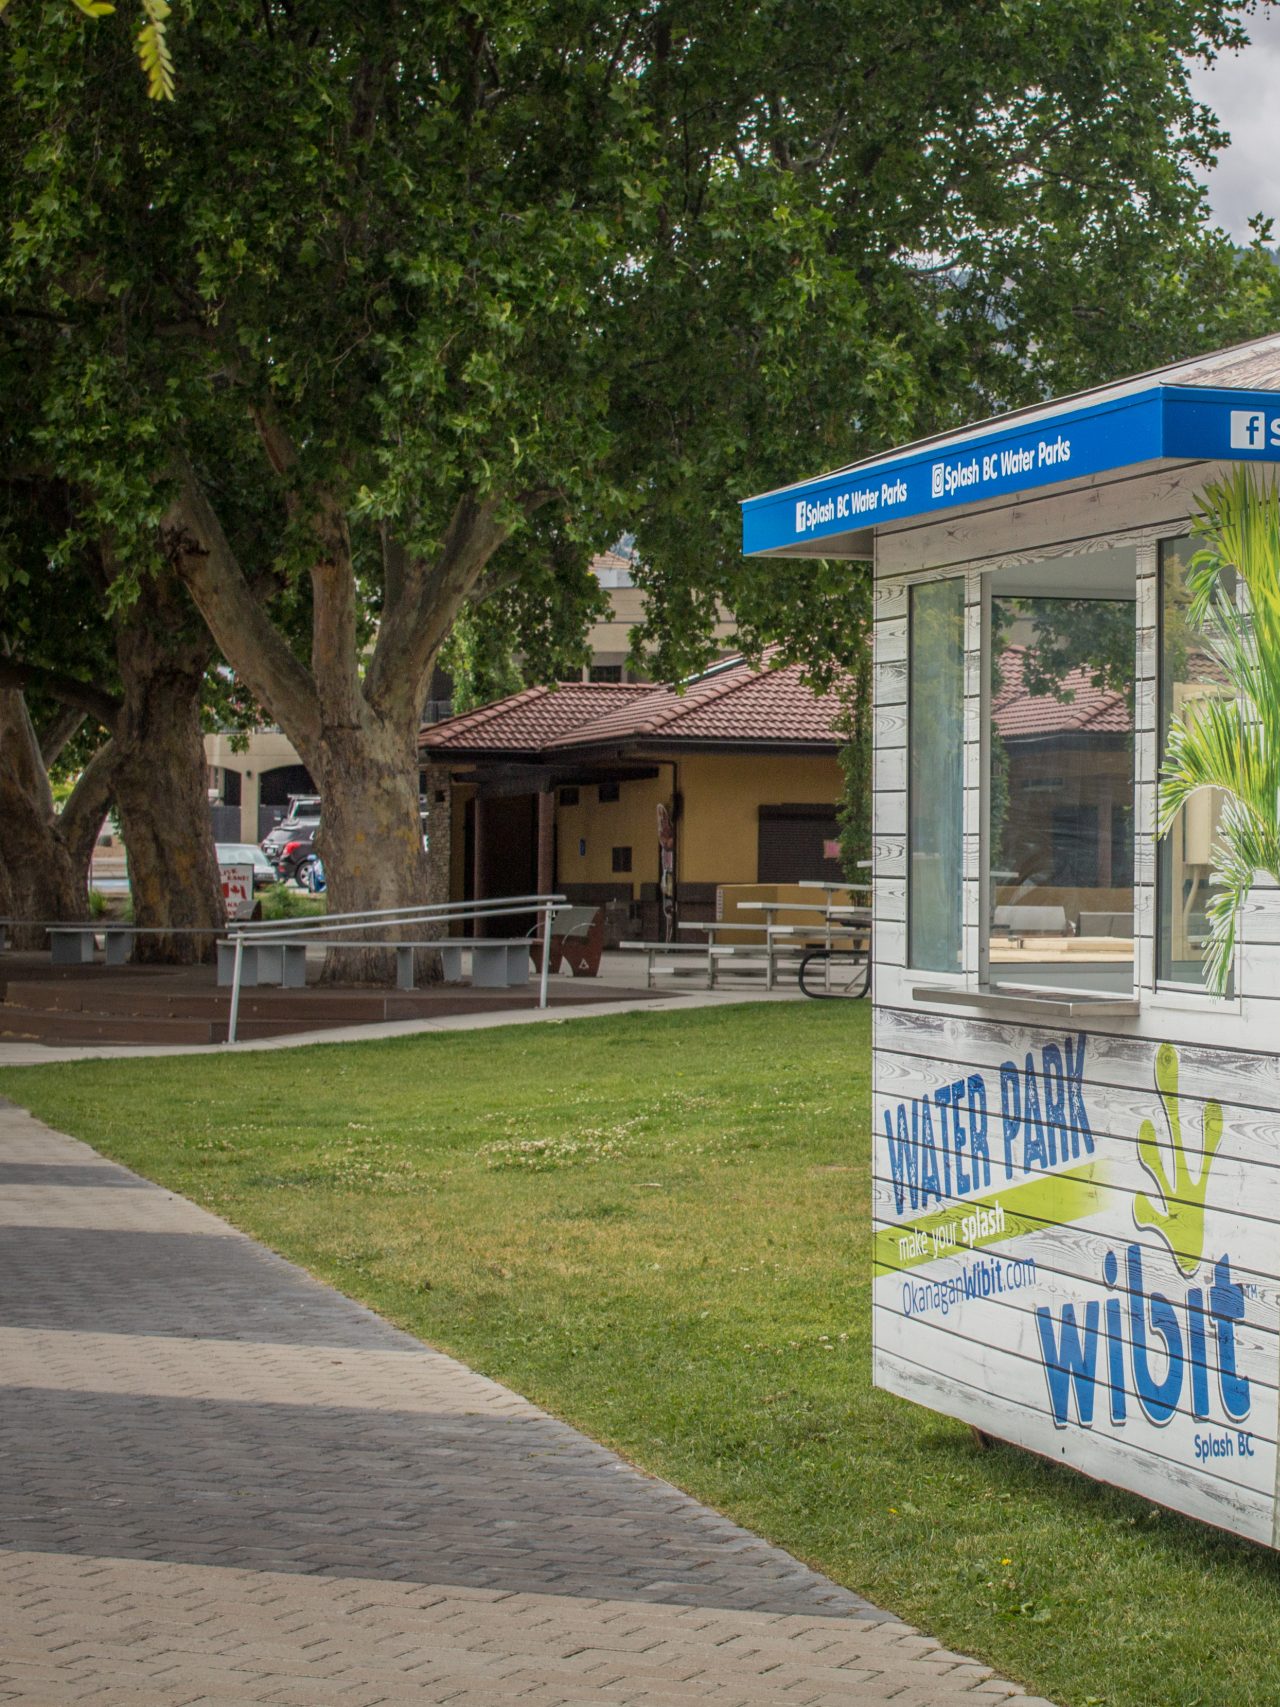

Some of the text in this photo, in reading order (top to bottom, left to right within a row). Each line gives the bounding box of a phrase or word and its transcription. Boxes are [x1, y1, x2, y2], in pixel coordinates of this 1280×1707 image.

[944, 435, 1071, 497] Splash BC Water Parks
[806, 497, 835, 532] Splash
[836, 493, 850, 519] BC
[851, 488, 880, 515] Water
[881, 478, 908, 507] Parks
[883, 1032, 1095, 1216] WATER PARK
[899, 1199, 1005, 1261] make your splash
[1036, 1243, 1250, 1430] wibit
[1194, 1431, 1255, 1464] Splash BC
